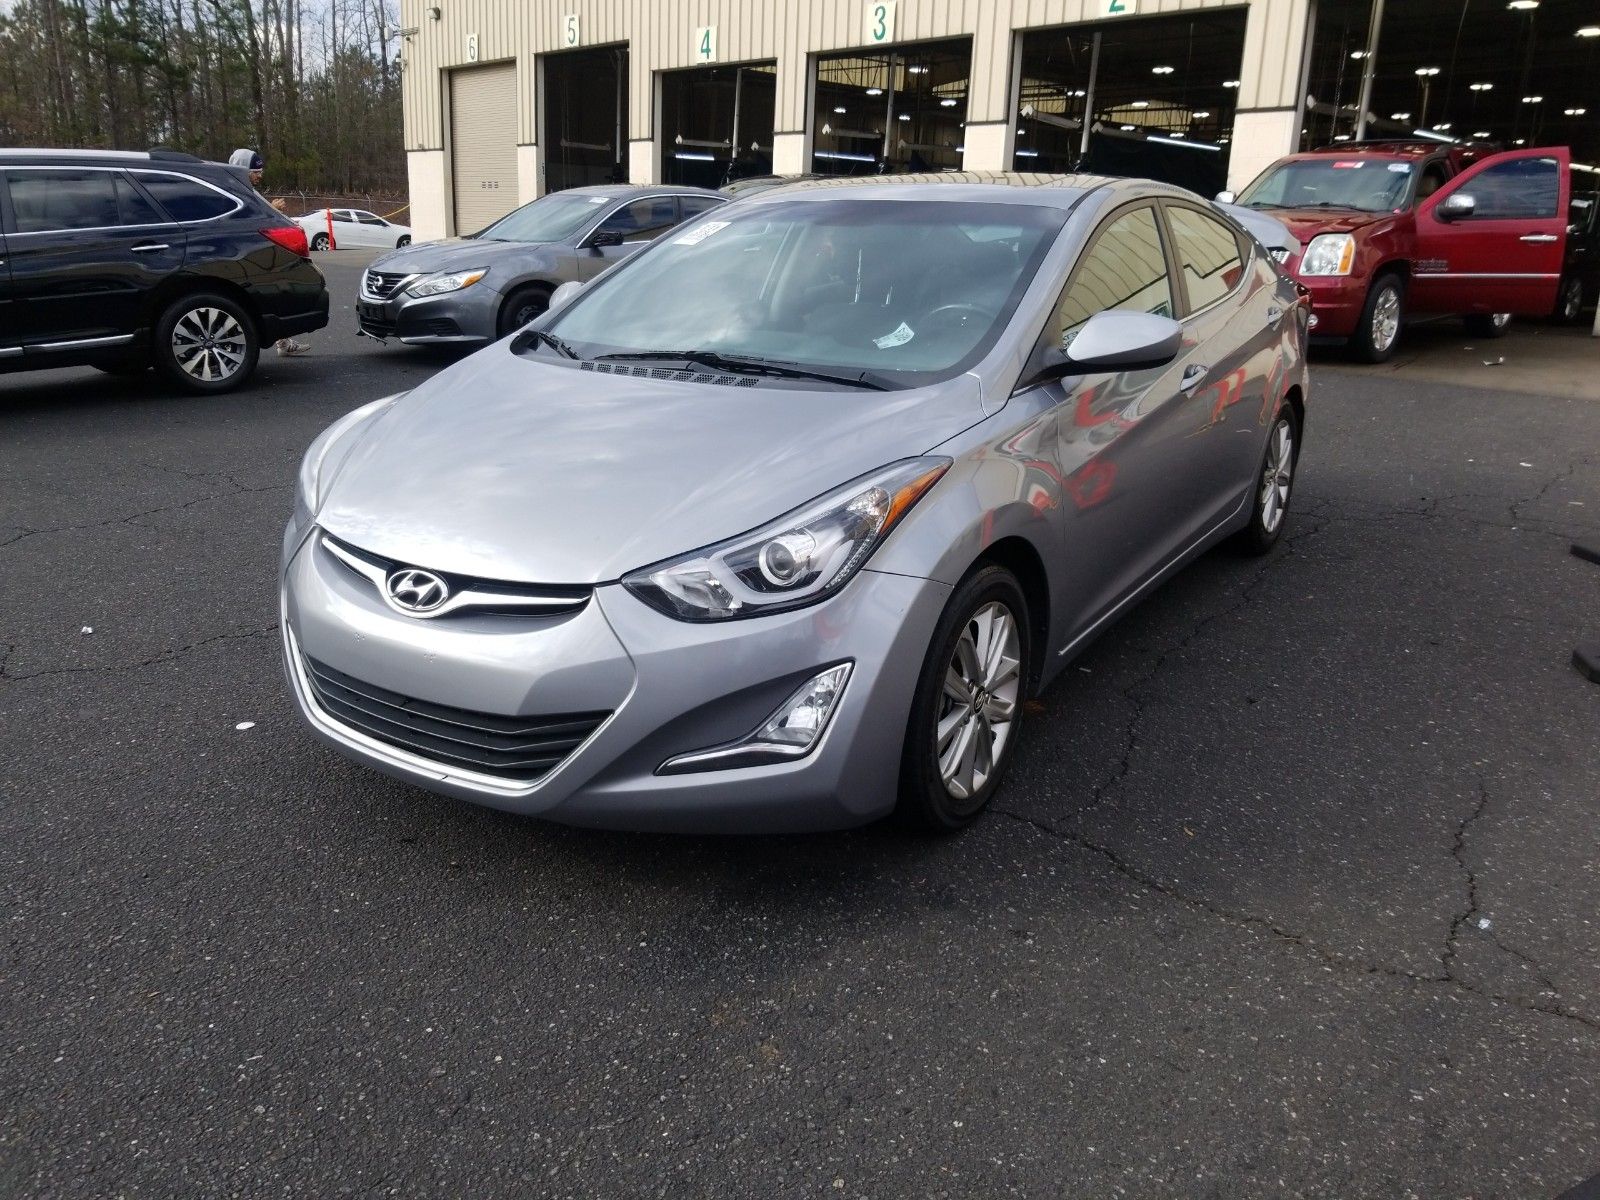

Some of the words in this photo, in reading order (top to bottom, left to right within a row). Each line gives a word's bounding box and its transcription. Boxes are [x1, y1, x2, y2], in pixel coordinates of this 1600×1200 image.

[567, 17, 576, 44] 5
[873, 5, 886, 41] 3
[468, 36, 476, 60] 6
[700, 29, 712, 60] 4
